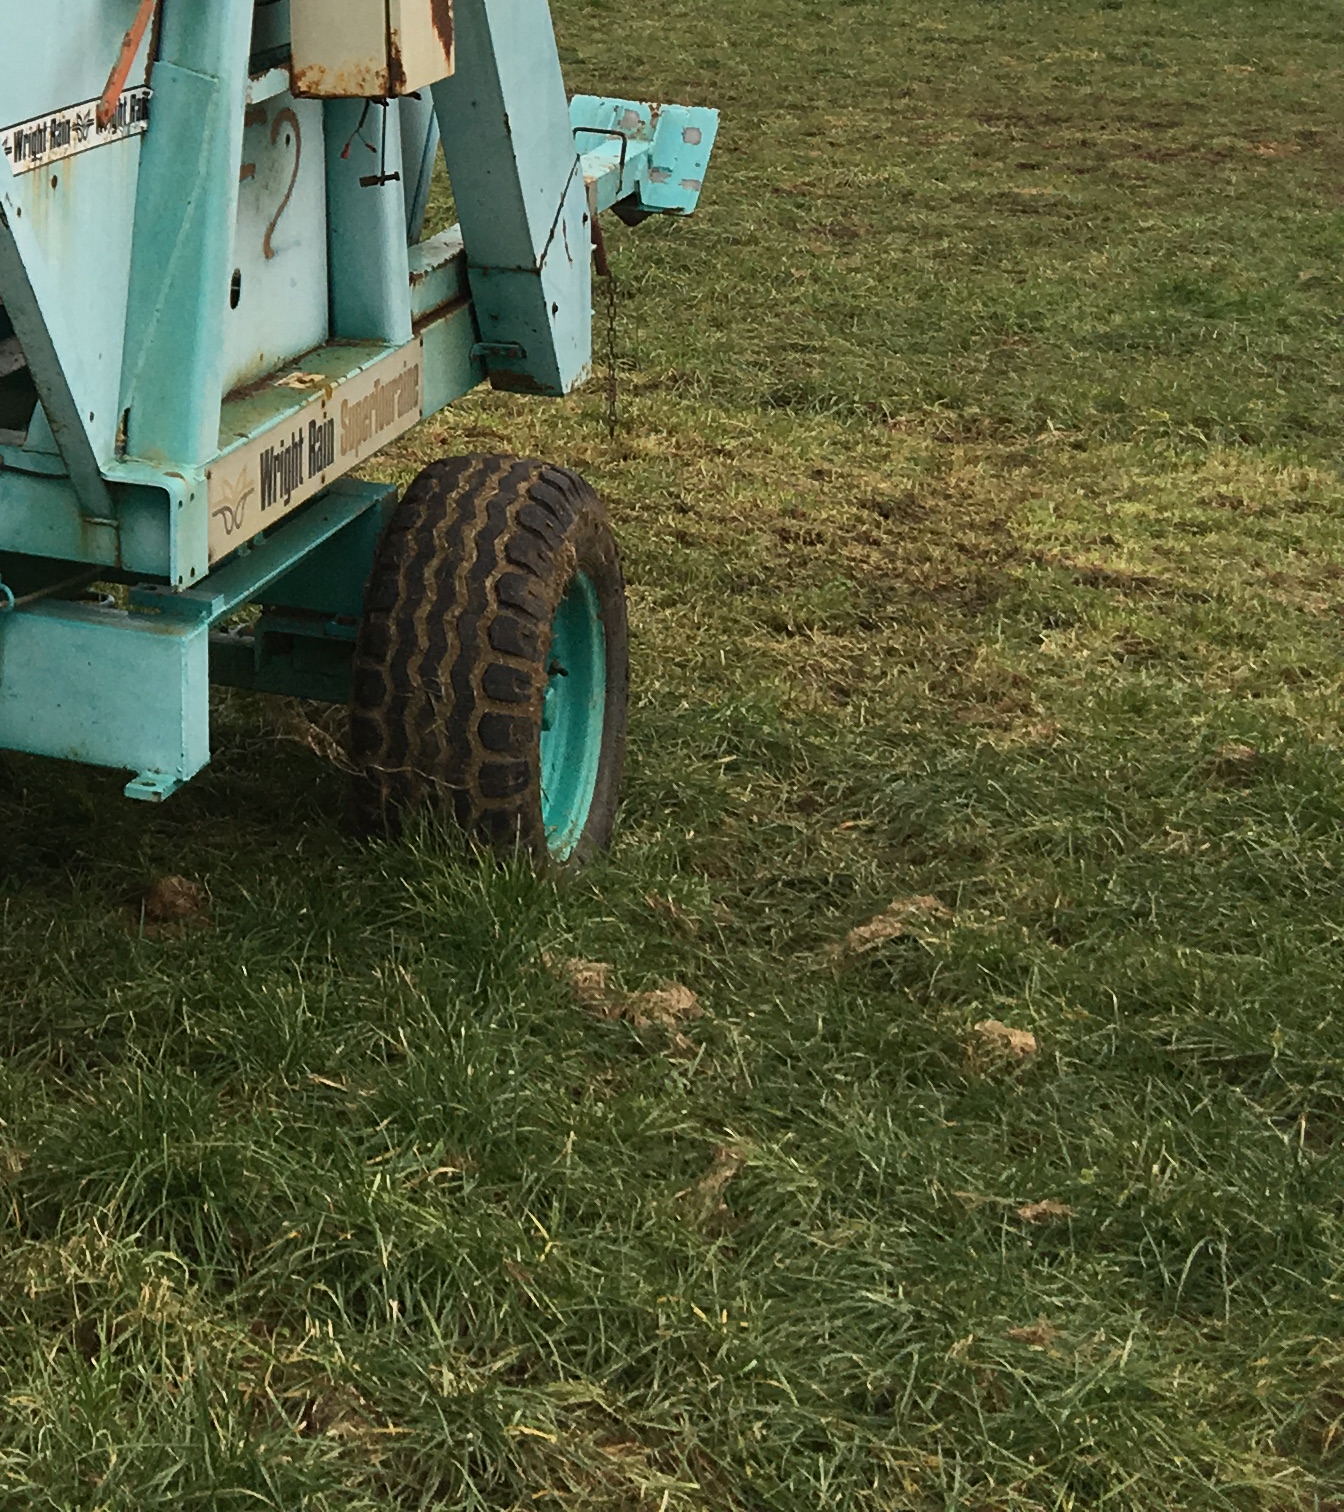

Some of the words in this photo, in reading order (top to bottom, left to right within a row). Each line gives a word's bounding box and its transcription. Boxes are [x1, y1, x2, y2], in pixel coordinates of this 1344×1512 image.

[14, 121, 47, 163] Wright
[50, 114, 70, 150] Rain
[260, 427, 304, 511] Wright
[308, 411, 335, 479] Rain
